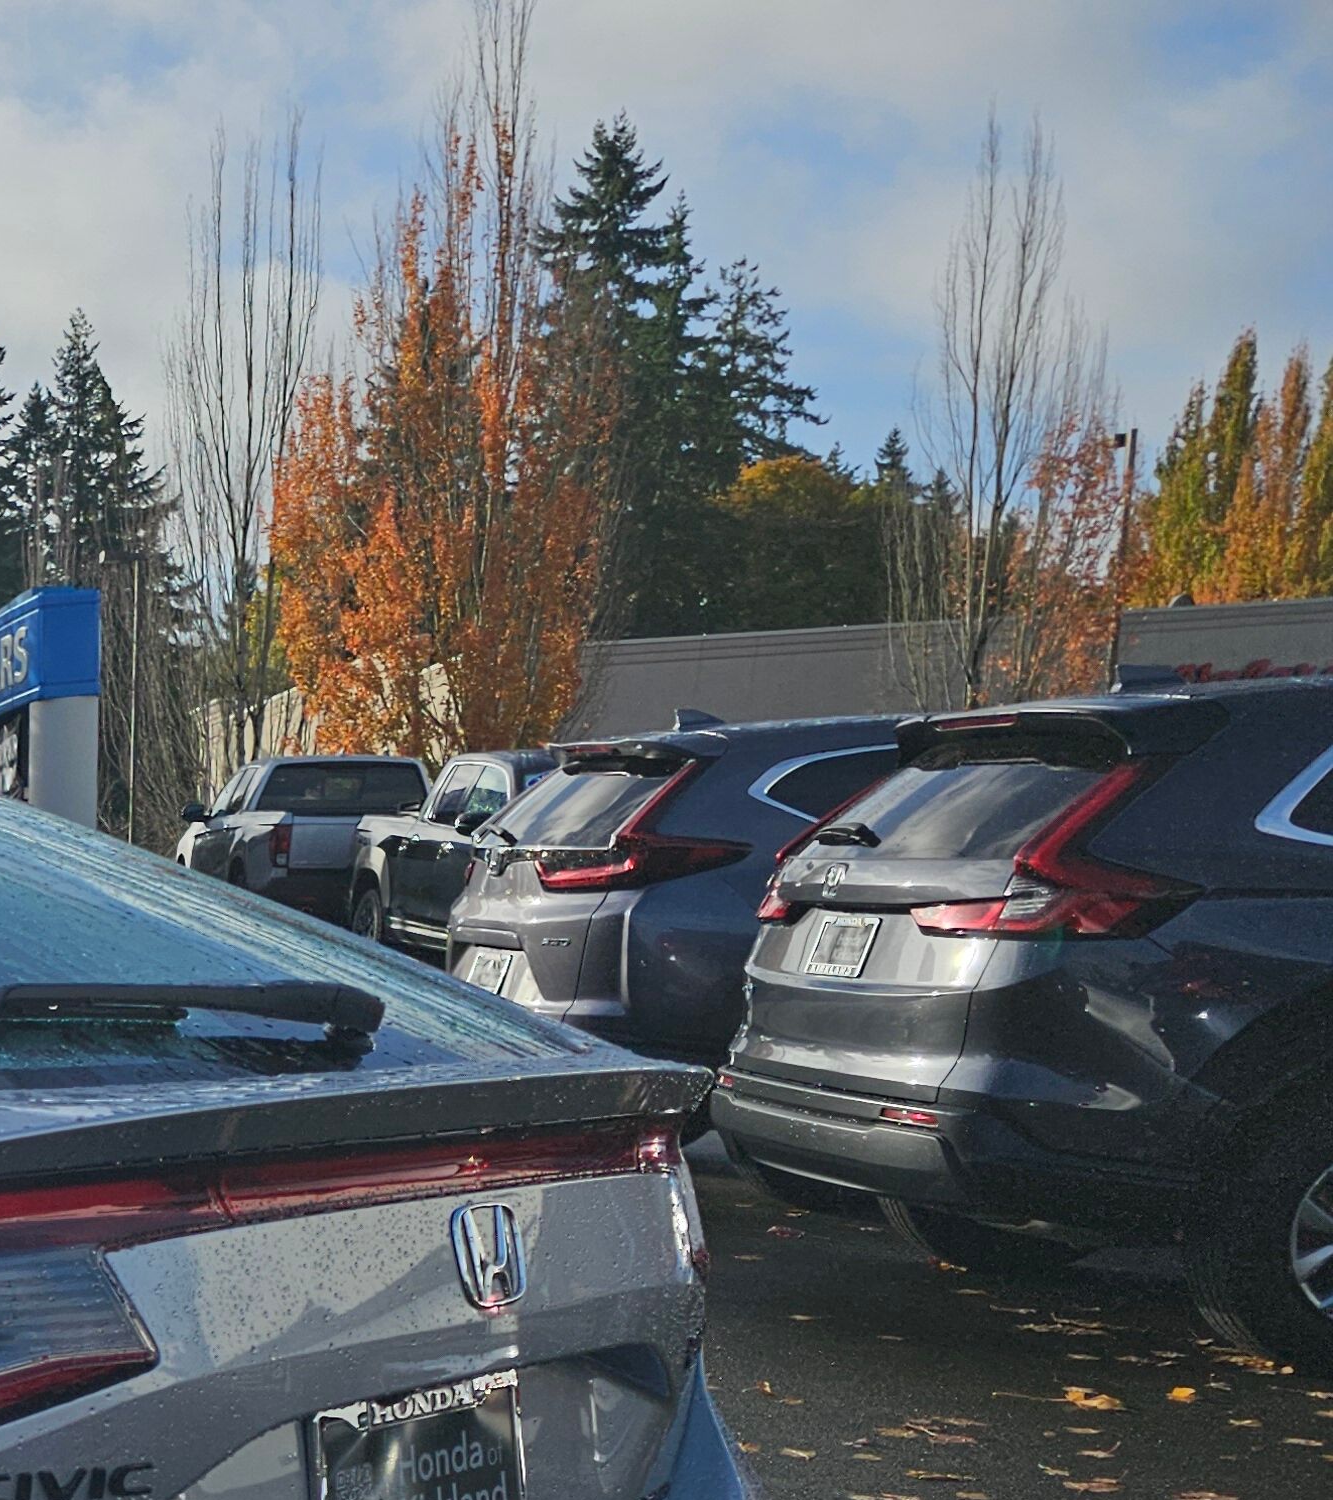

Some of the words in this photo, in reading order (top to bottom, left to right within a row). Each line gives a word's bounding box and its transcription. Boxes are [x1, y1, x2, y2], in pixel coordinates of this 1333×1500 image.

[371, 1381, 475, 1426] HONDA
[398, 1431, 484, 1486] Honda
[488, 1444, 503, 1466] of
